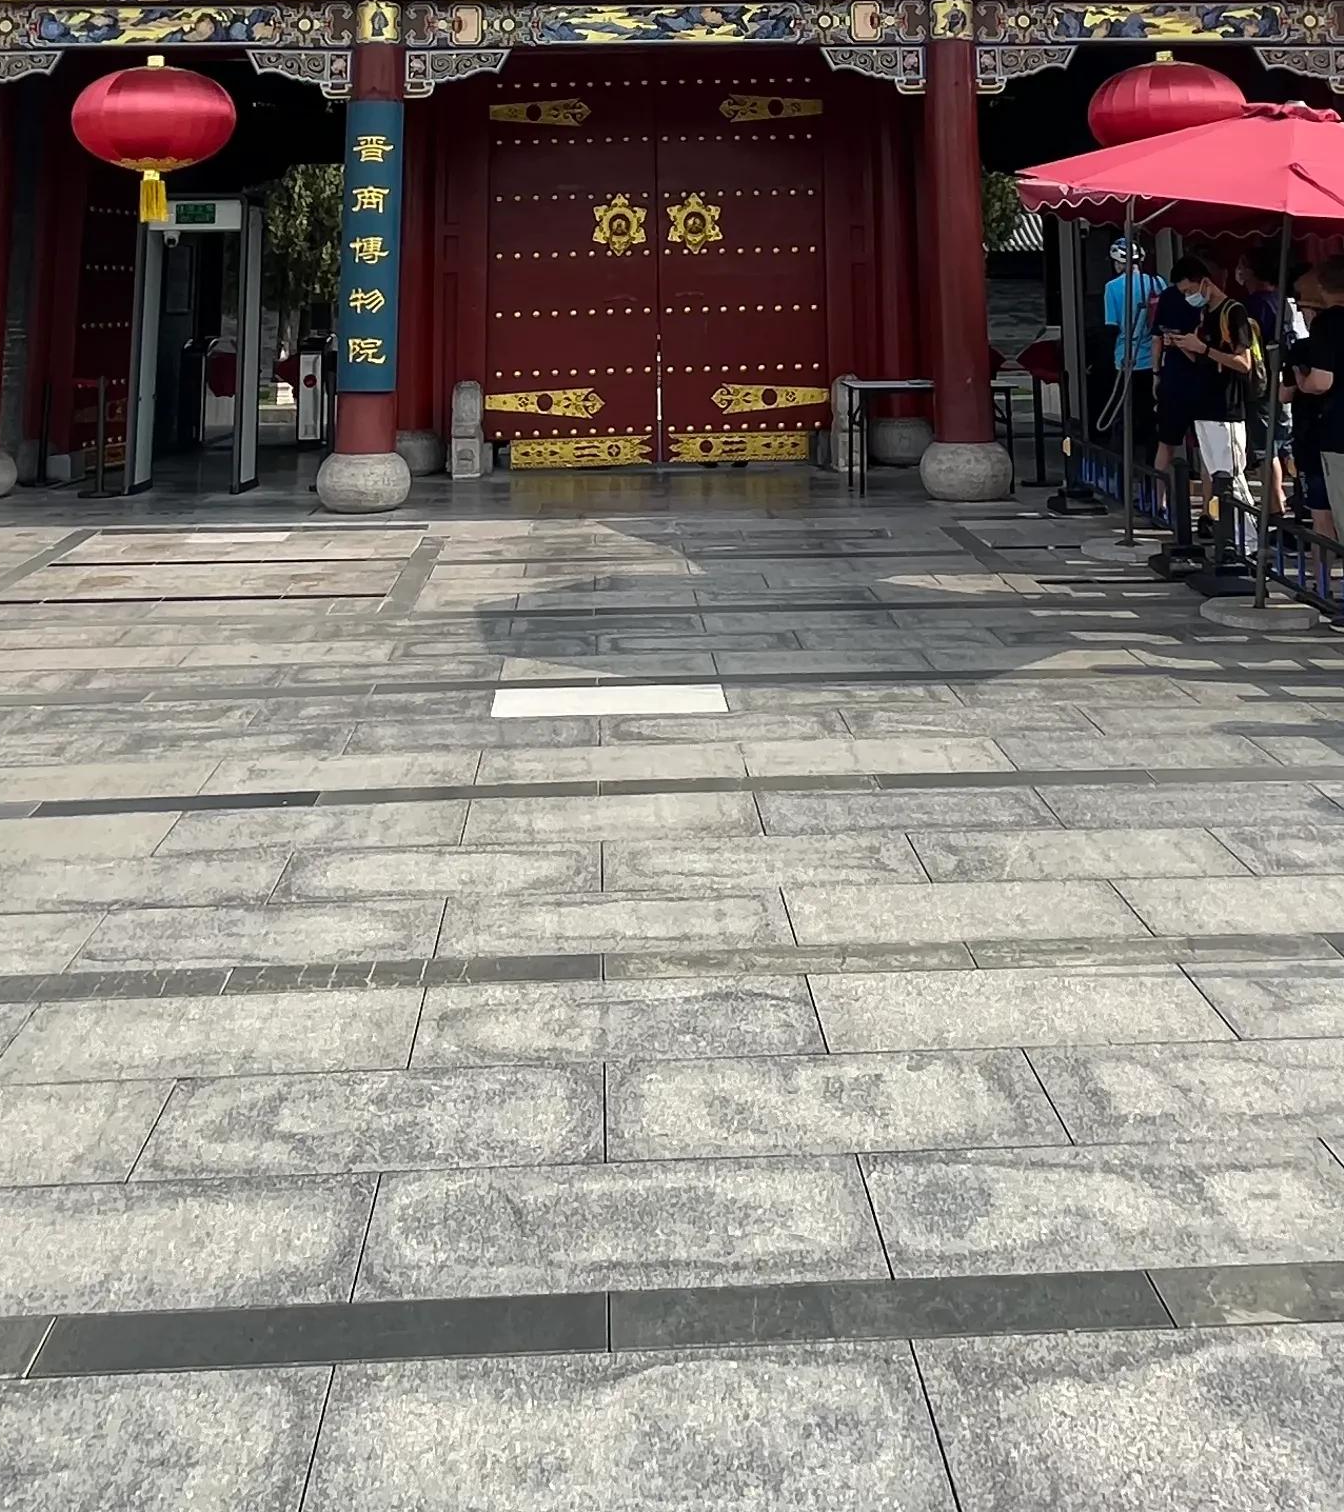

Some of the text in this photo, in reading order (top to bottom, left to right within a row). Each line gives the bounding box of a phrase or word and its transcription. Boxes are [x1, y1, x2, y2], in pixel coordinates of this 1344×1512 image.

[348, 135, 394, 364] 晋商博物院
